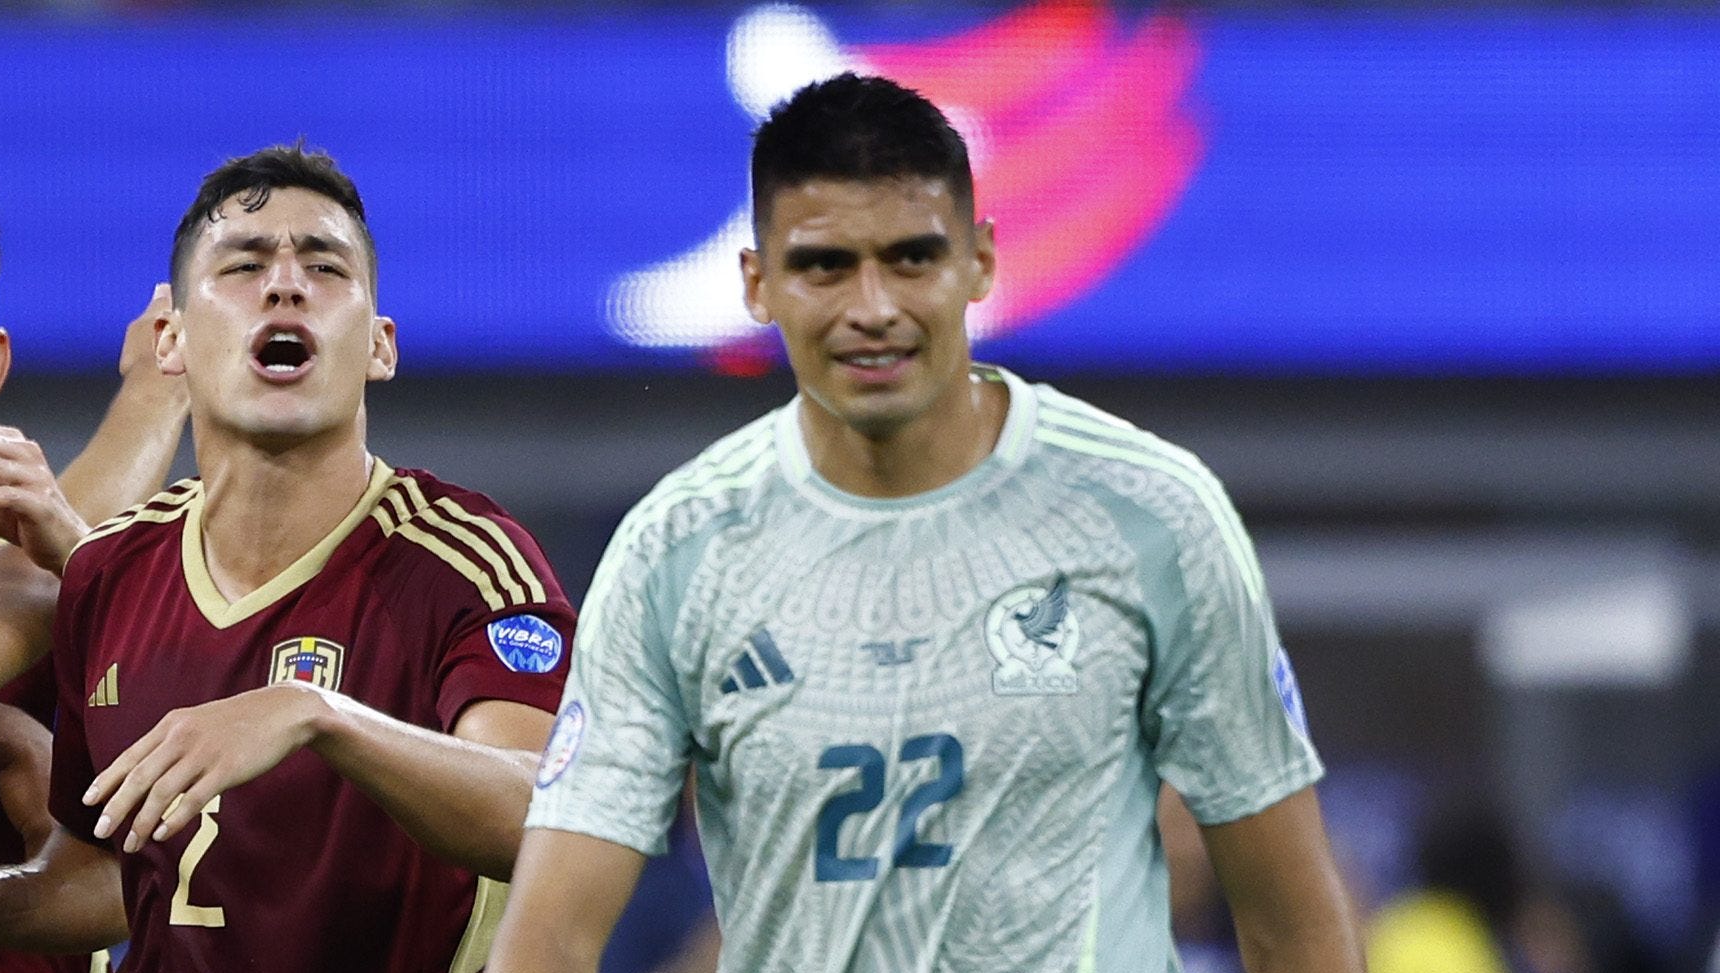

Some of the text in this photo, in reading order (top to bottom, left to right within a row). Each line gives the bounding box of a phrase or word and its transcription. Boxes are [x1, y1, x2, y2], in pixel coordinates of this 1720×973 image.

[498, 627, 554, 651] VIBRA
[161, 792, 226, 929] 2
[815, 732, 964, 882] 22
